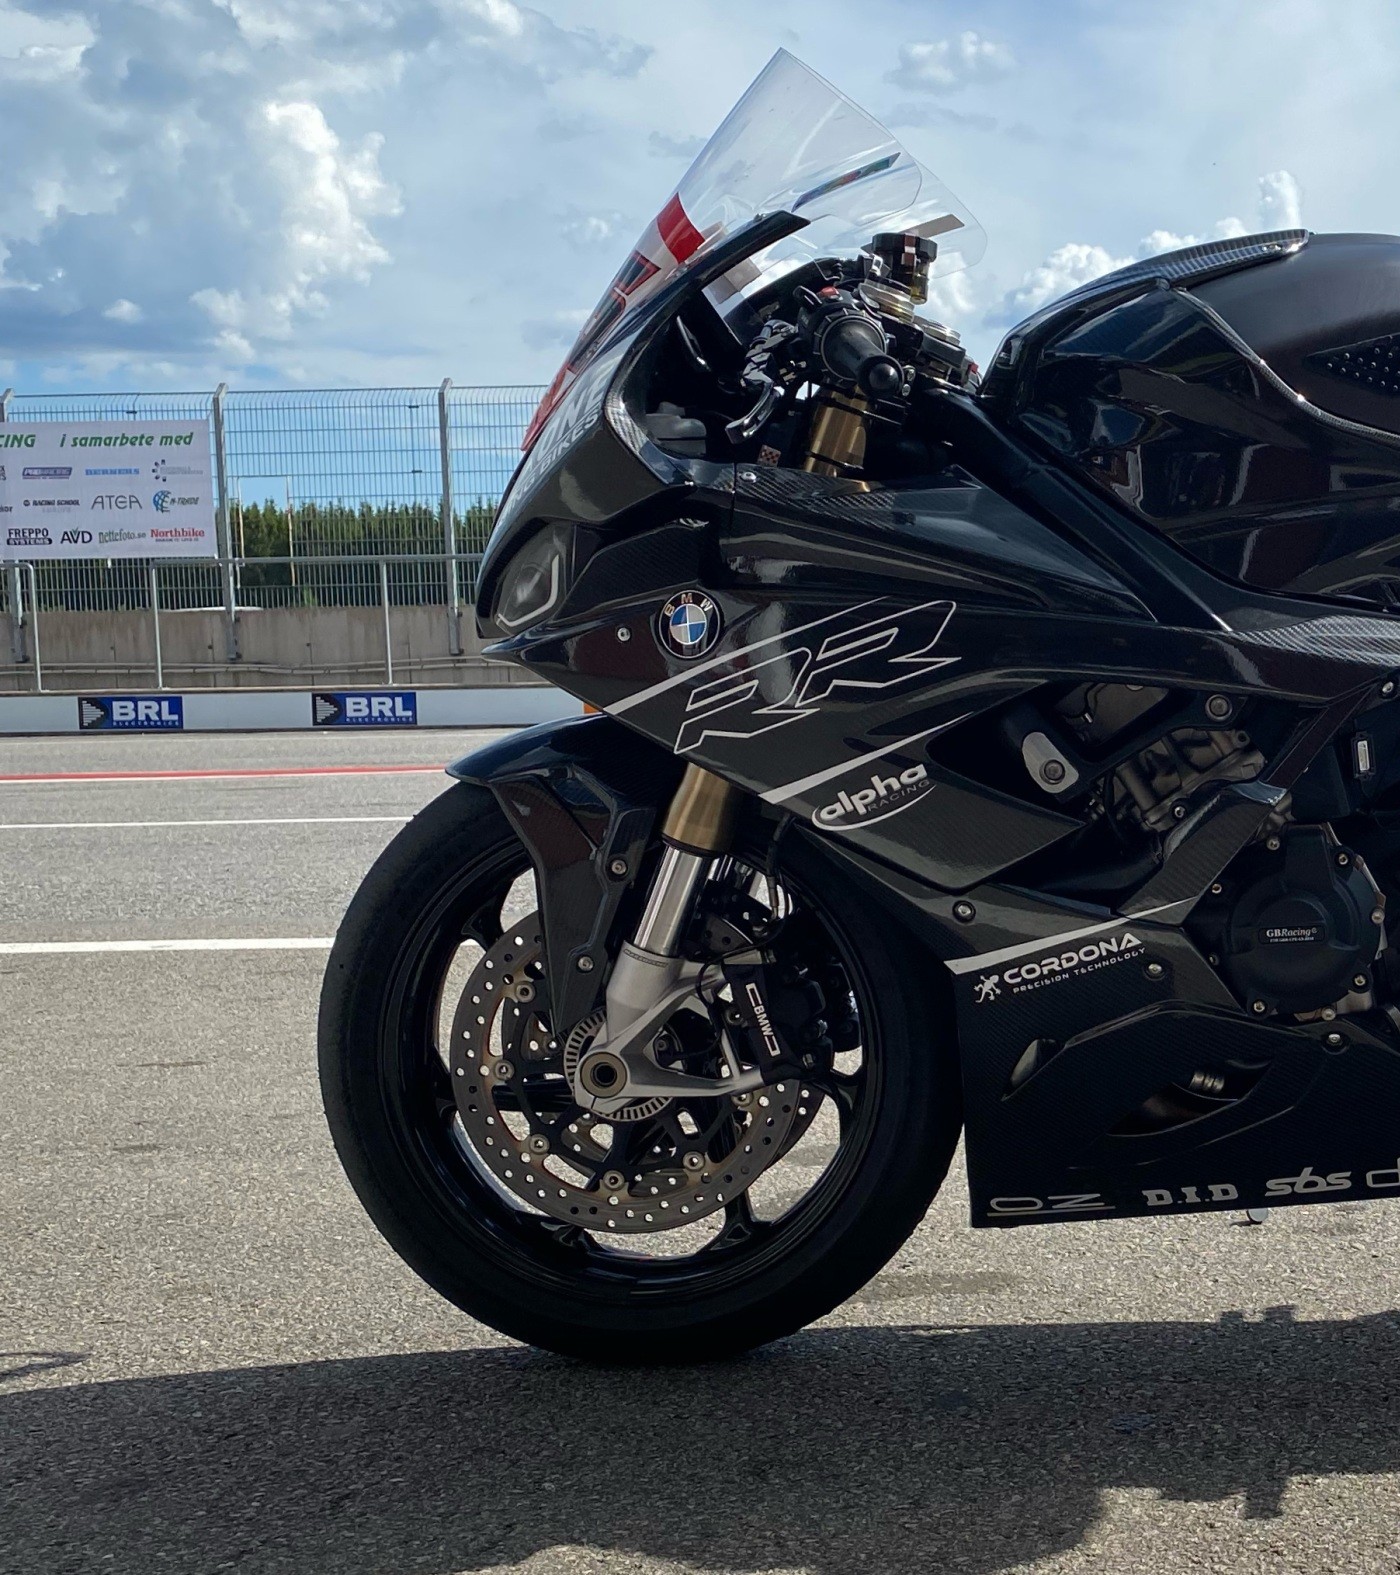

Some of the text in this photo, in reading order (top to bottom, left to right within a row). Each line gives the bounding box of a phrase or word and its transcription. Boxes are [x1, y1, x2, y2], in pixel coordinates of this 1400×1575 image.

[60, 433, 67, 448] i
[71, 432, 154, 447] samarbete
[159, 431, 194, 446] med
[8, 527, 49, 538] FREPPO
[150, 527, 205, 538] Northbike
[664, 592, 714, 617] BMW
[112, 700, 179, 721] BRL
[345, 696, 413, 717] BRL
[820, 764, 928, 821] alpha
[867, 779, 930, 812] RACING
[1003, 932, 1142, 984] CORDONA
[1013, 947, 1146, 994] PRECISION TECHNOLOGY
[753, 1004, 774, 1036] BMW
[989, 1193, 1105, 1213] OZ
[1142, 1183, 1239, 1206] D.I.D
